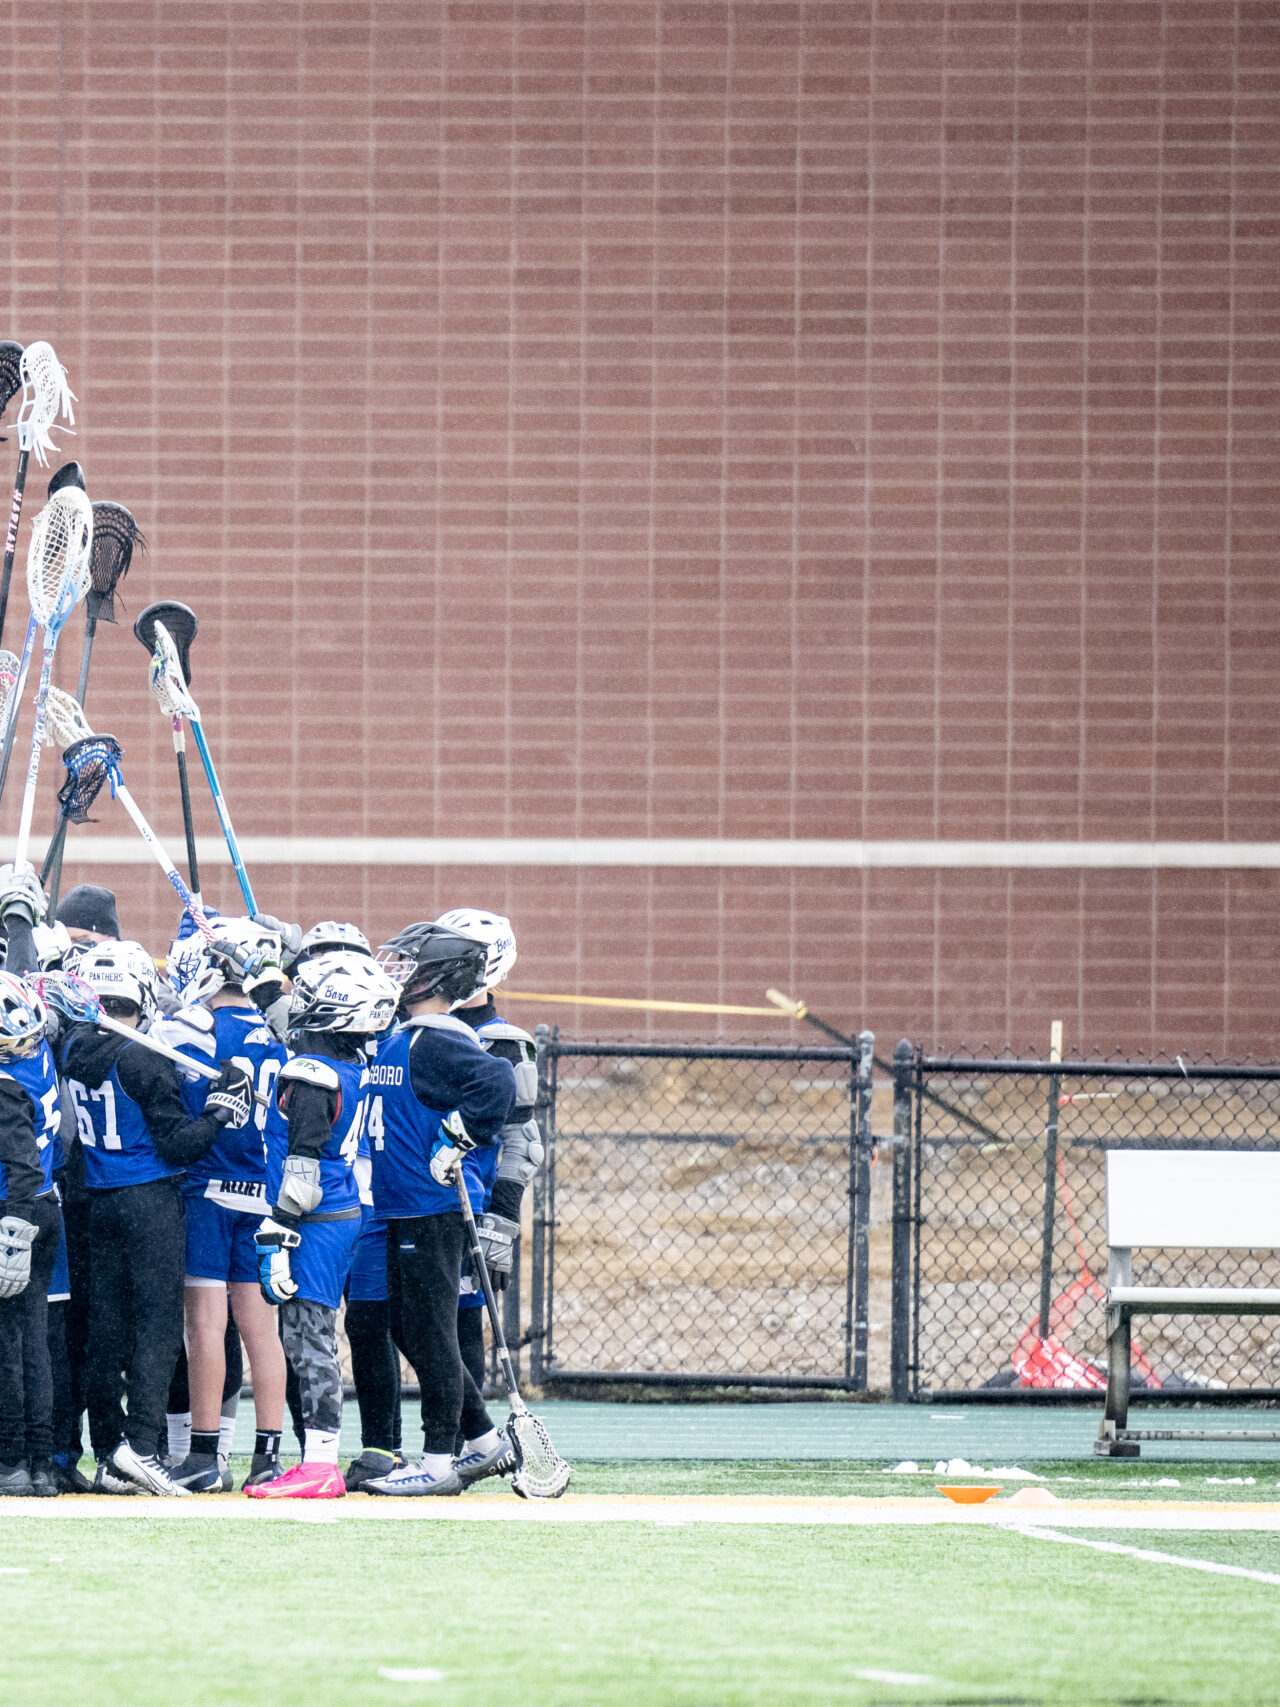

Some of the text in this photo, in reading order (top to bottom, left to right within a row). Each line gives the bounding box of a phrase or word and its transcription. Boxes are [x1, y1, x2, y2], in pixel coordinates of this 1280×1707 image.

[28, 722, 45, 785] DRAGON
[89, 972, 124, 983] PANTHERS
[324, 984, 349, 1002] Boro
[295, 1060, 320, 1073] STX
[68, 1078, 122, 1150] 67
